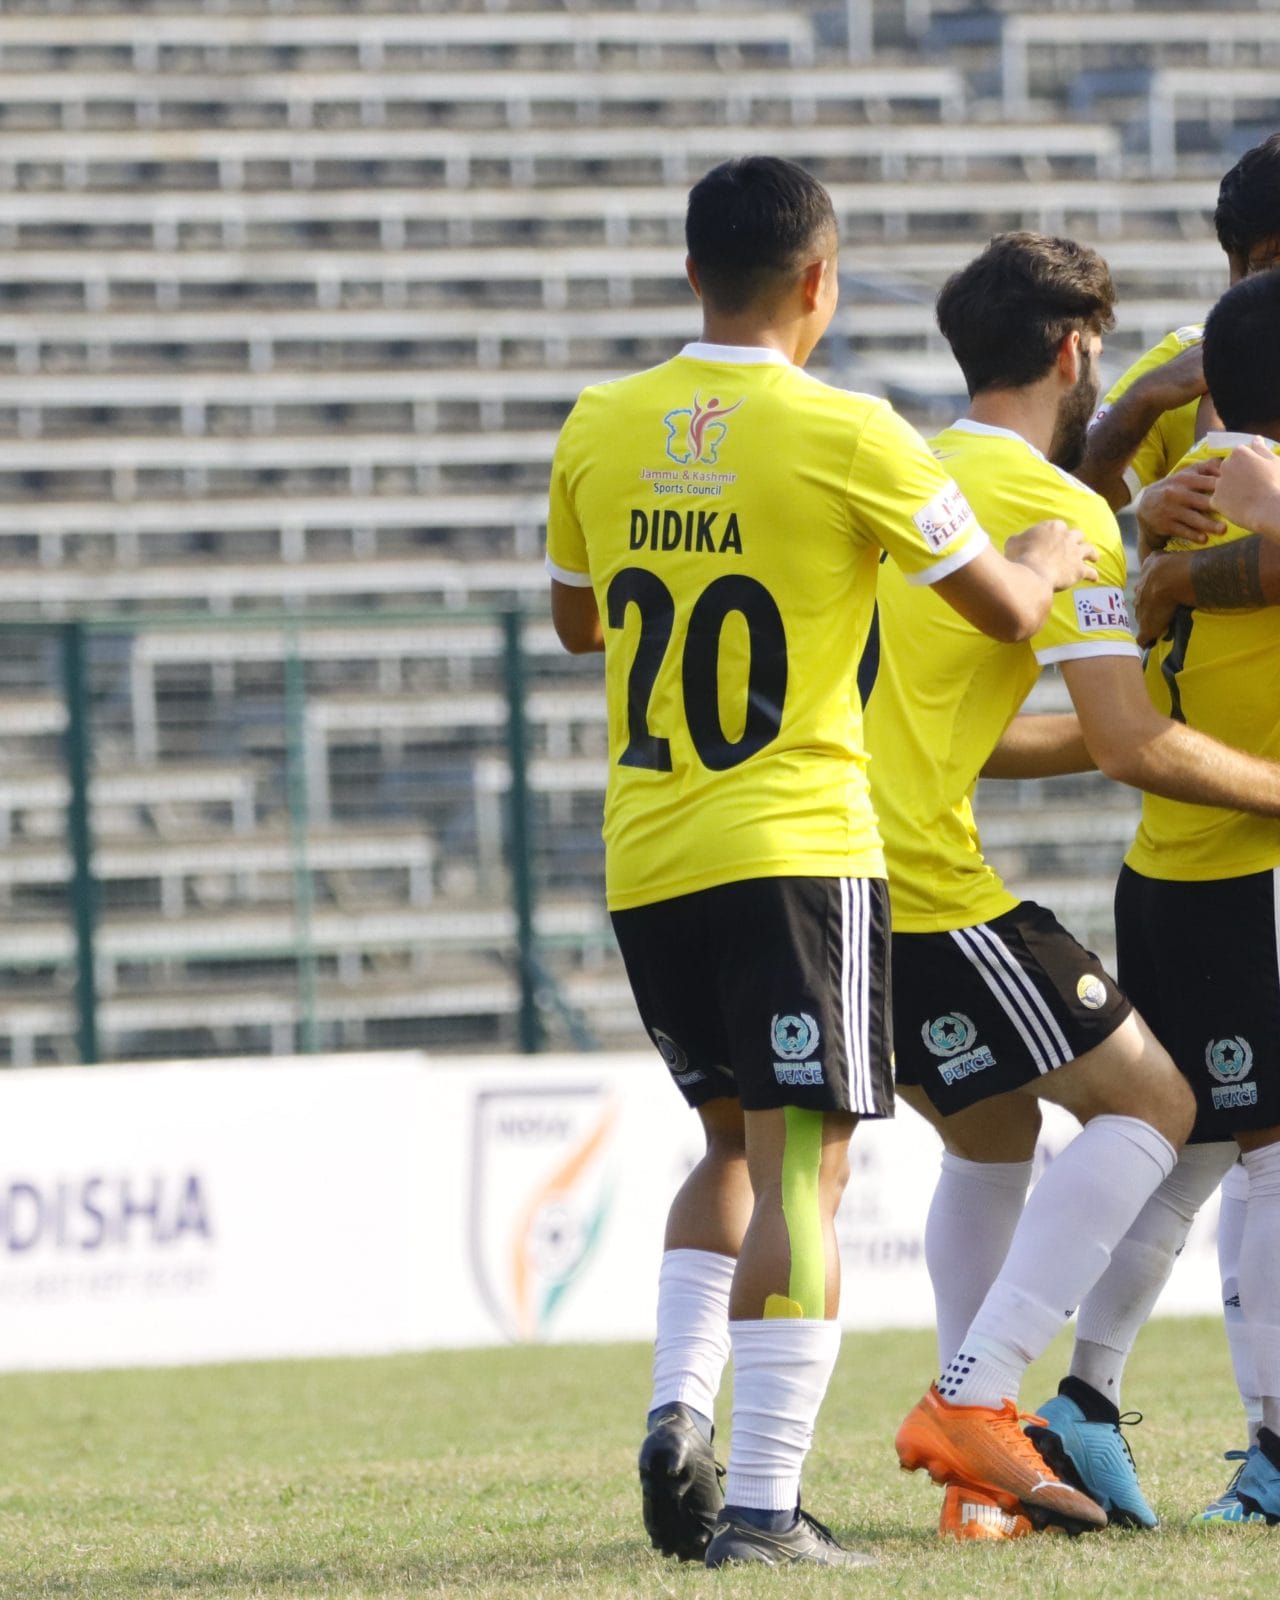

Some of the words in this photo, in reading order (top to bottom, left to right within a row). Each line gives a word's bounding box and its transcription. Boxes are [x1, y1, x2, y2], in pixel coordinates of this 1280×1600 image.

[641, 468, 678, 480] Jammu
[682, 470, 690, 480] &
[692, 471, 737, 482] Kashmir
[653, 482, 683, 494] Sports
[686, 484, 721, 495] Council
[629, 509, 743, 555] DIDIKA
[606, 567, 789, 772] 20
[776, 1070, 824, 1085] PEACE
[942, 1052, 996, 1085] PEACE
[1213, 1089, 1257, 1109] PEACE
